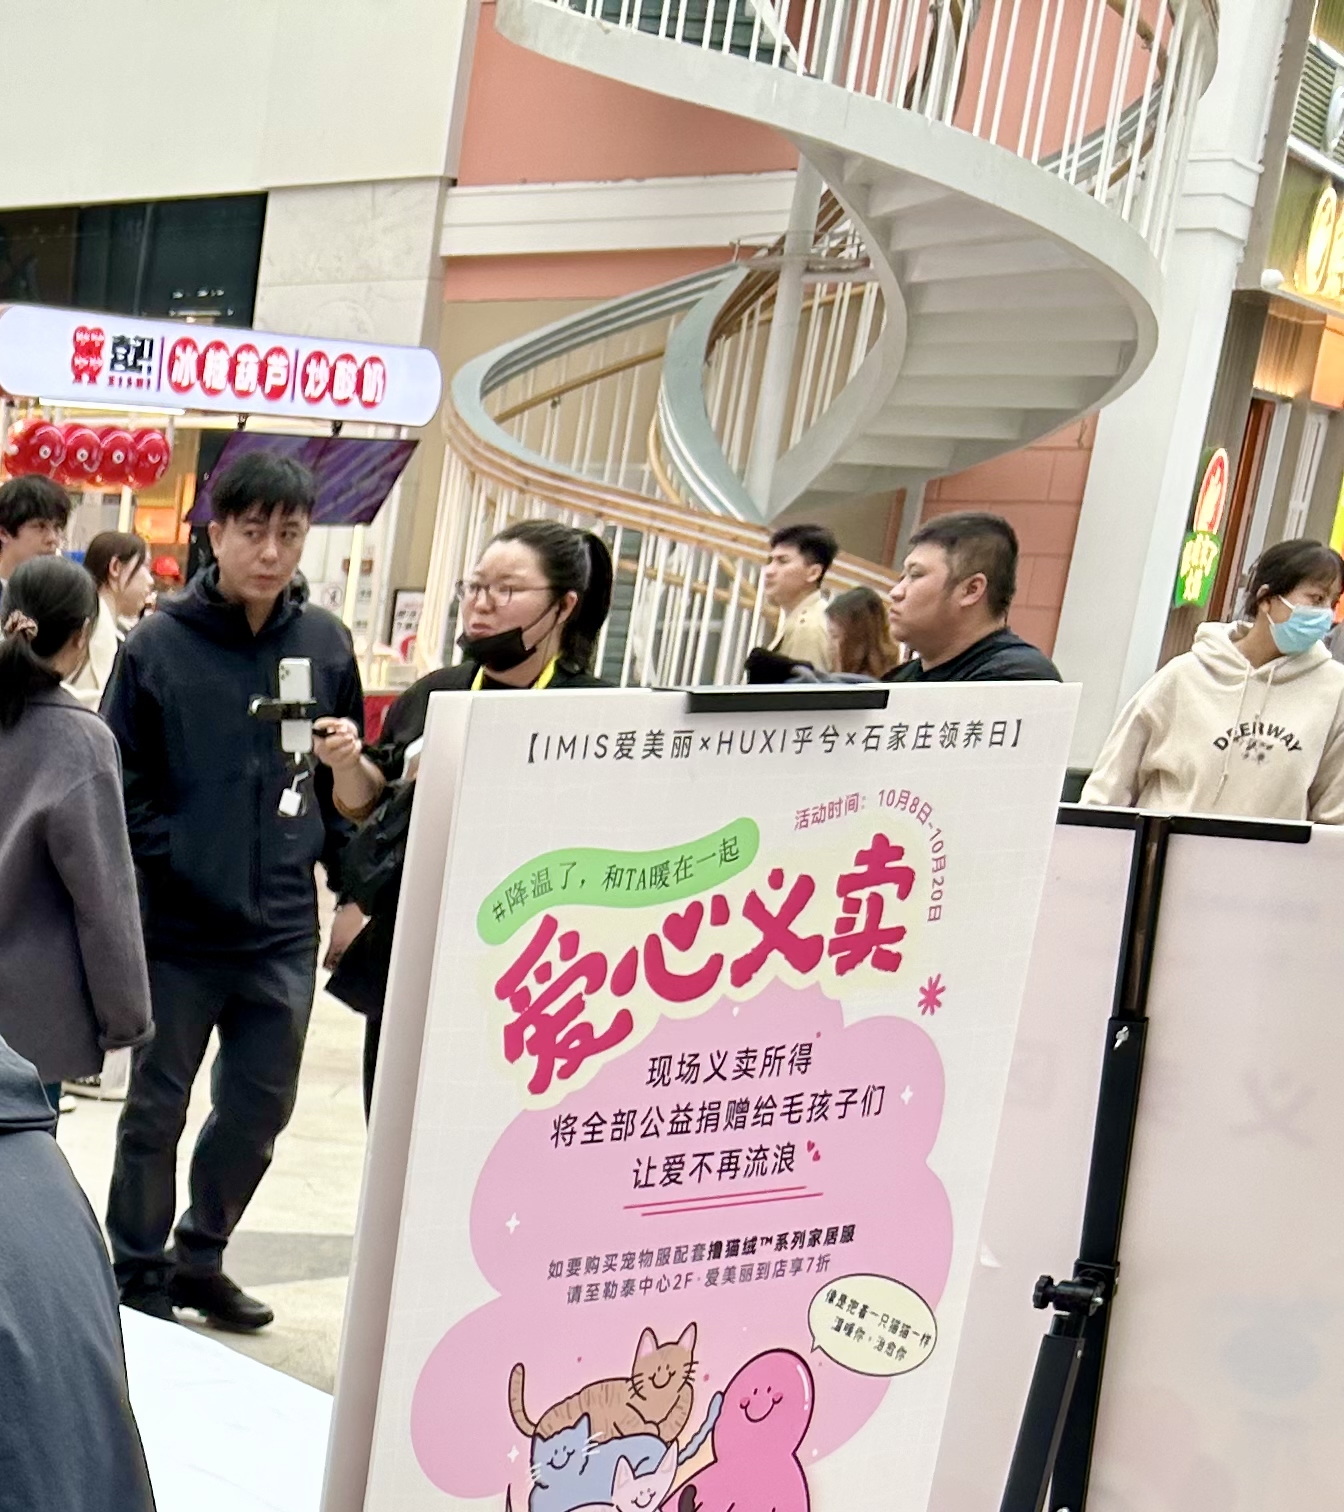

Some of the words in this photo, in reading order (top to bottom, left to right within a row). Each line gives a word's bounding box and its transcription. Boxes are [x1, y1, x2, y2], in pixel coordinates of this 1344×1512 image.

[170, 342, 289, 396] 冰糖葫芦
[494, 832, 916, 1095] 爱心义卖
[647, 1041, 813, 1089] 现场义卖所得
[550, 1084, 887, 1149] 将全部公益捐赠给毛孩子们
[632, 1141, 797, 1191] 让爱不再流浪
